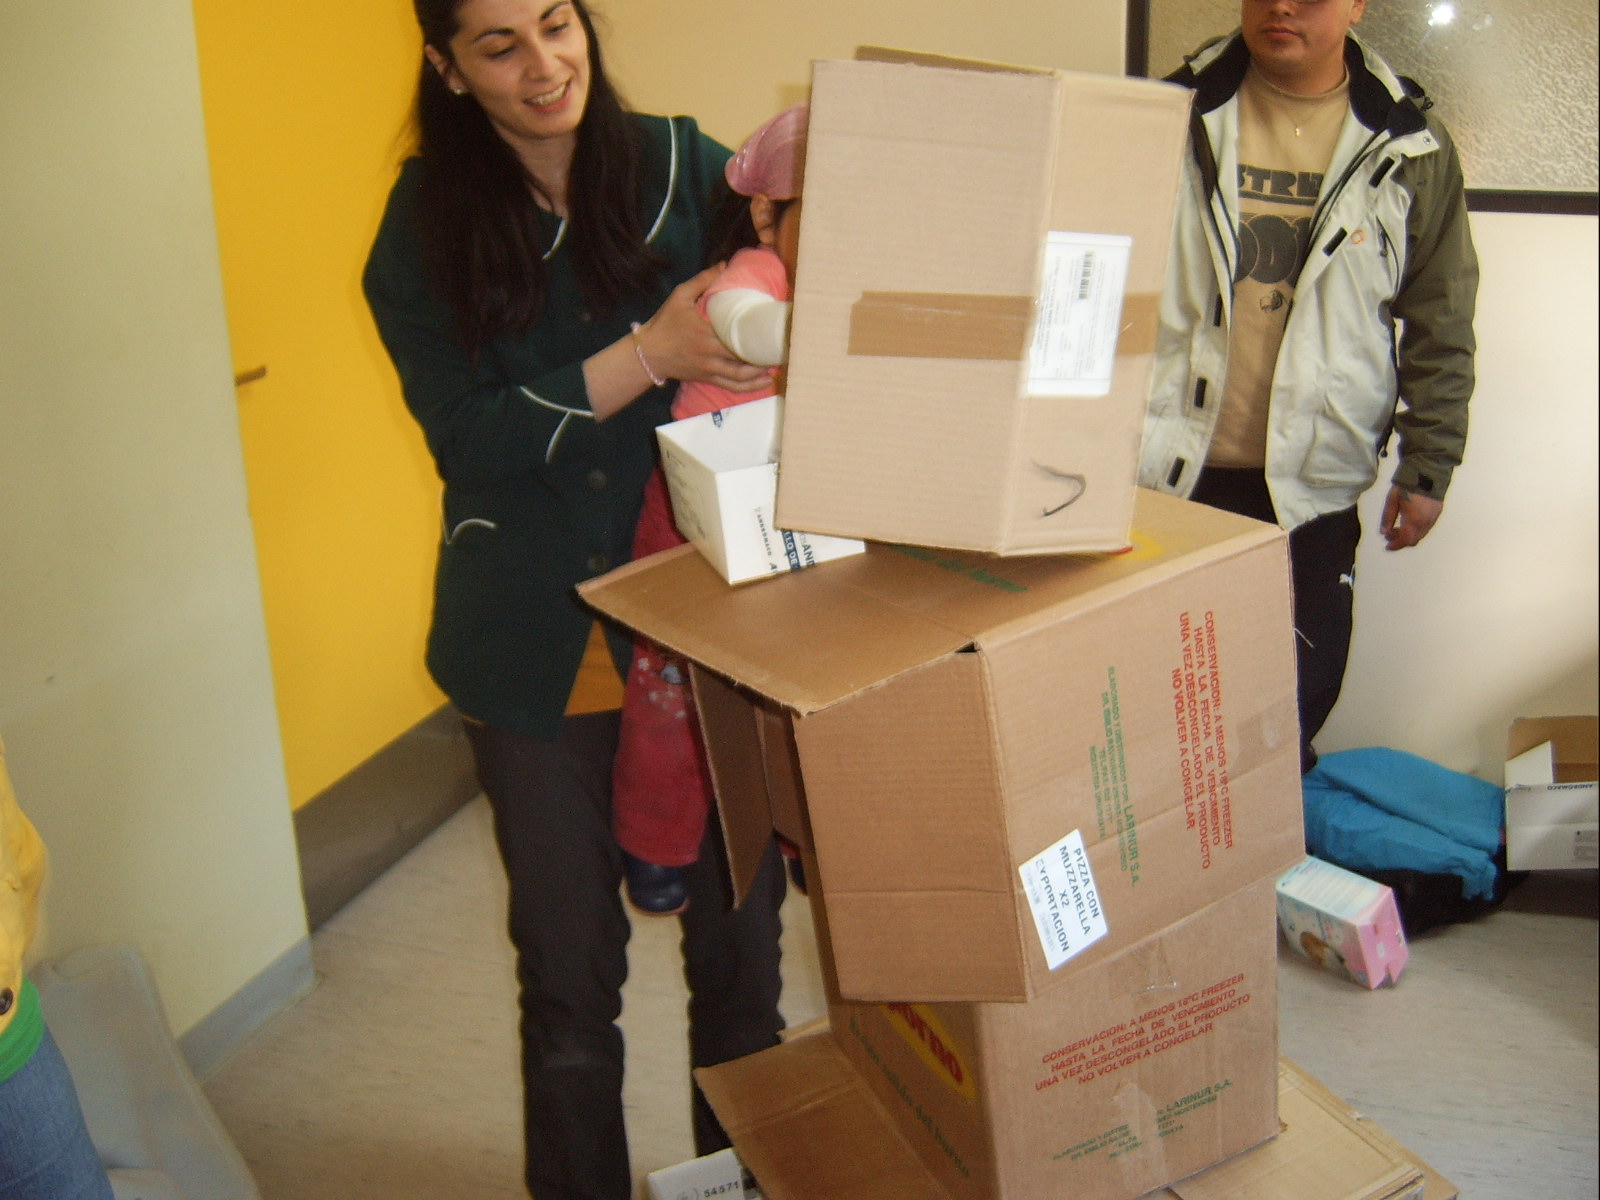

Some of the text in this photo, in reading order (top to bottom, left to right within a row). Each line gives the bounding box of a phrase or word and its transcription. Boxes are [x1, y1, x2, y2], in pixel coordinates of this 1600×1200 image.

[1205, 611, 1221, 711] CONSERVACION:
[1172, 668, 1195, 829] NO VOLVER A CONGELAR
[1179, 612, 1211, 870] UNA VEZ DESCONGELADO EL PRODUCTO
[1194, 627, 1220, 846] HASTA LA FECHA DE VENCIMIENTO
[1214, 714, 1222, 723] A
[1215, 725, 1226, 768] MENOS
[1123, 804, 1138, 861] LARINUR
[1221, 797, 1233, 849] FREEZER
[1059, 845, 1091, 935] MUZZARELLA
[1059, 890, 1070, 907] X2
[1074, 848, 1100, 918] PIZZA CON
[1130, 863, 1140, 887] S.A.
[1035, 994, 1250, 1091] UNA VEZ DESCONGELADO EL PRODUCTO
[1042, 1024, 1126, 1064] CONSERVACION:
[1129, 1018, 1137, 1027] A
[1138, 1003, 1176, 1022] MENOS
[1201, 973, 1244, 998] FREEZER
[1051, 989, 1236, 1072] HASTA LA FECHA DE VENCIMIENTO
[1078, 1022, 1213, 1085] NO VOLVER A CONGELAR
[1166, 1086, 1211, 1112] LARINUR
[1214, 1079, 1233, 1092] S.A.
[703, 1181, 739, 1198] 54571
